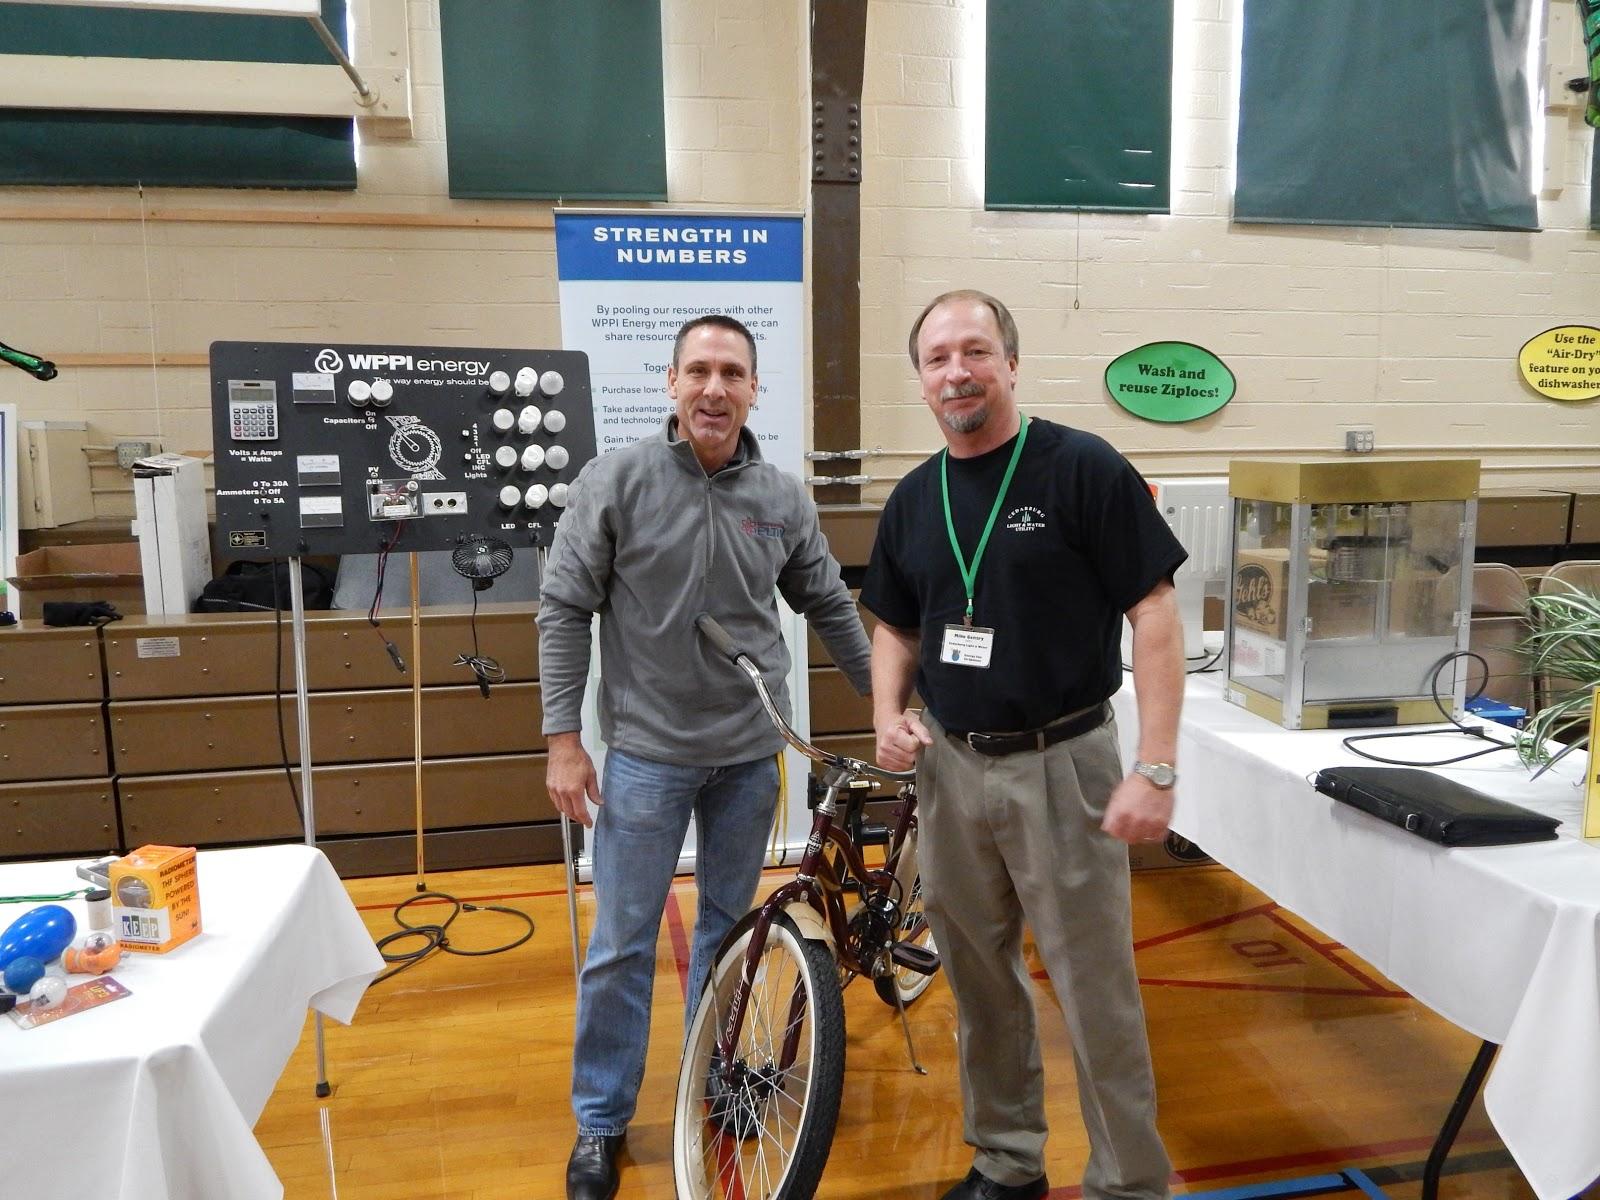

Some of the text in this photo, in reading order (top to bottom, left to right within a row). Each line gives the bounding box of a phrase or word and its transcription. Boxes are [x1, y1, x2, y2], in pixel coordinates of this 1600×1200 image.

[593, 227, 768, 243] STRENGTH IN
[617, 249, 747, 264] NUMBERS
[596, 304, 773, 316] By pooling our resources with other
[591, 318, 619, 327] WPPI
[622, 318, 656, 329] Energy
[604, 332, 633, 341] share
[1554, 333, 1596, 345] Use the
[347, 354, 491, 376] WPPI energy
[1529, 362, 1600, 376] feature on yo
[1138, 363, 1206, 380] Wash and
[393, 378, 412, 386] way
[446, 378, 476, 386] should
[478, 378, 490, 386] be
[602, 386, 642, 394] Purchase
[1119, 383, 1219, 399] reuse Ziplocs!
[602, 405, 622, 413] Take
[624, 405, 668, 414] advantage
[323, 417, 366, 425] Capacitors
[621, 416, 664, 425] technologi
[604, 435, 624, 443] Gain
[757, 433, 766, 441] to
[768, 432, 779, 441] be
[260, 449, 283, 457] Amps
[464, 472, 488, 480] Lights
[160, 855, 197, 878] RADIOMETER
[165, 881, 195, 900] POWERED
[171, 894, 191, 910] BY THE
[120, 943, 161, 952] RADIOMETER
